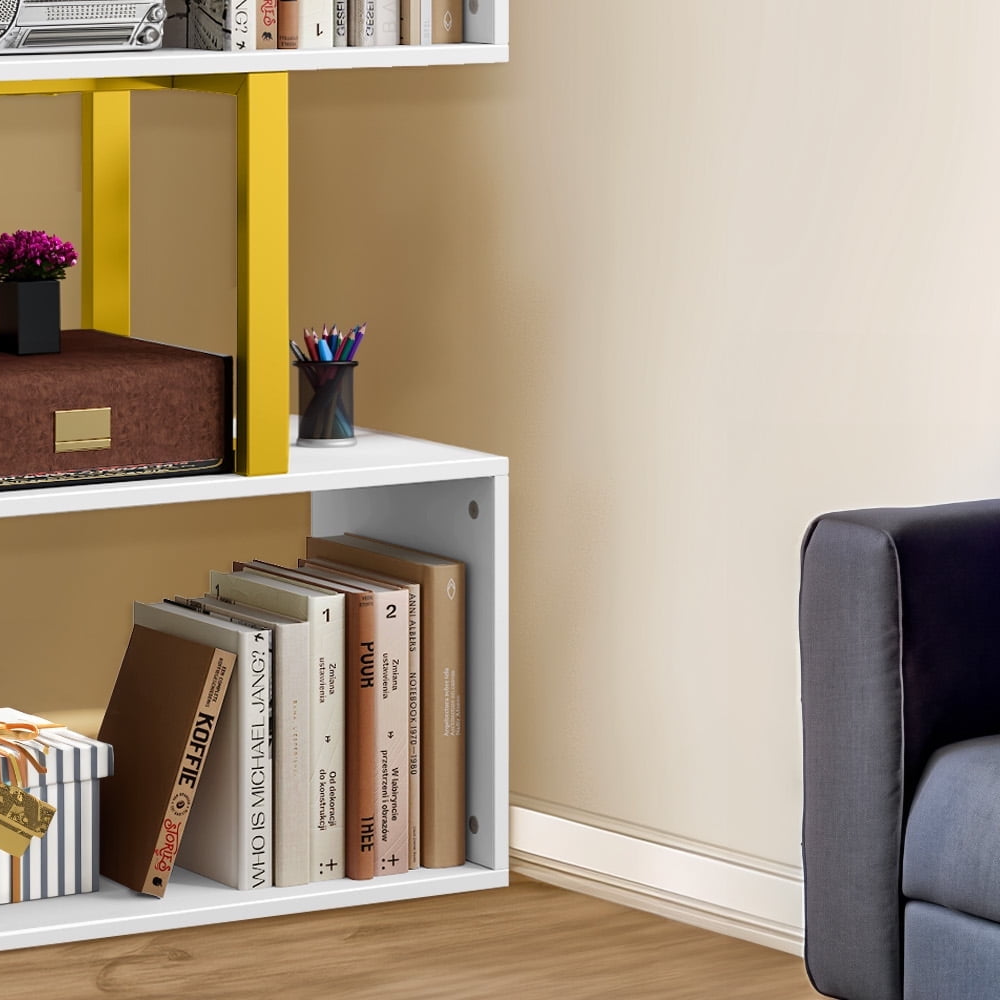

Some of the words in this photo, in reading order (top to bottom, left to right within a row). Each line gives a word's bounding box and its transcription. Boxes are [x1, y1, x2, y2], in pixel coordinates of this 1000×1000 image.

[316, 24, 323, 36] 1
[323, 608, 330, 622] 1
[386, 604, 396, 619] 2
[212, 677, 224, 703] COMPLETE
[251, 651, 265, 713] JANG?
[178, 712, 214, 789] KOFFIE
[252, 716, 265, 807] MICHAEL
[319, 769, 326, 780] do
[329, 771, 336, 784] Od
[381, 750, 389, 798] przestrzeni
[392, 768, 399, 777] W
[318, 782, 327, 830] konstrukcji
[328, 786, 337, 826] dekoracji
[390, 778, 399, 821] labiryncie
[252, 812, 265, 830] IS
[381, 804, 389, 842] obrazów
[154, 819, 181, 872] STORIES
[252, 836, 265, 888] WHO
